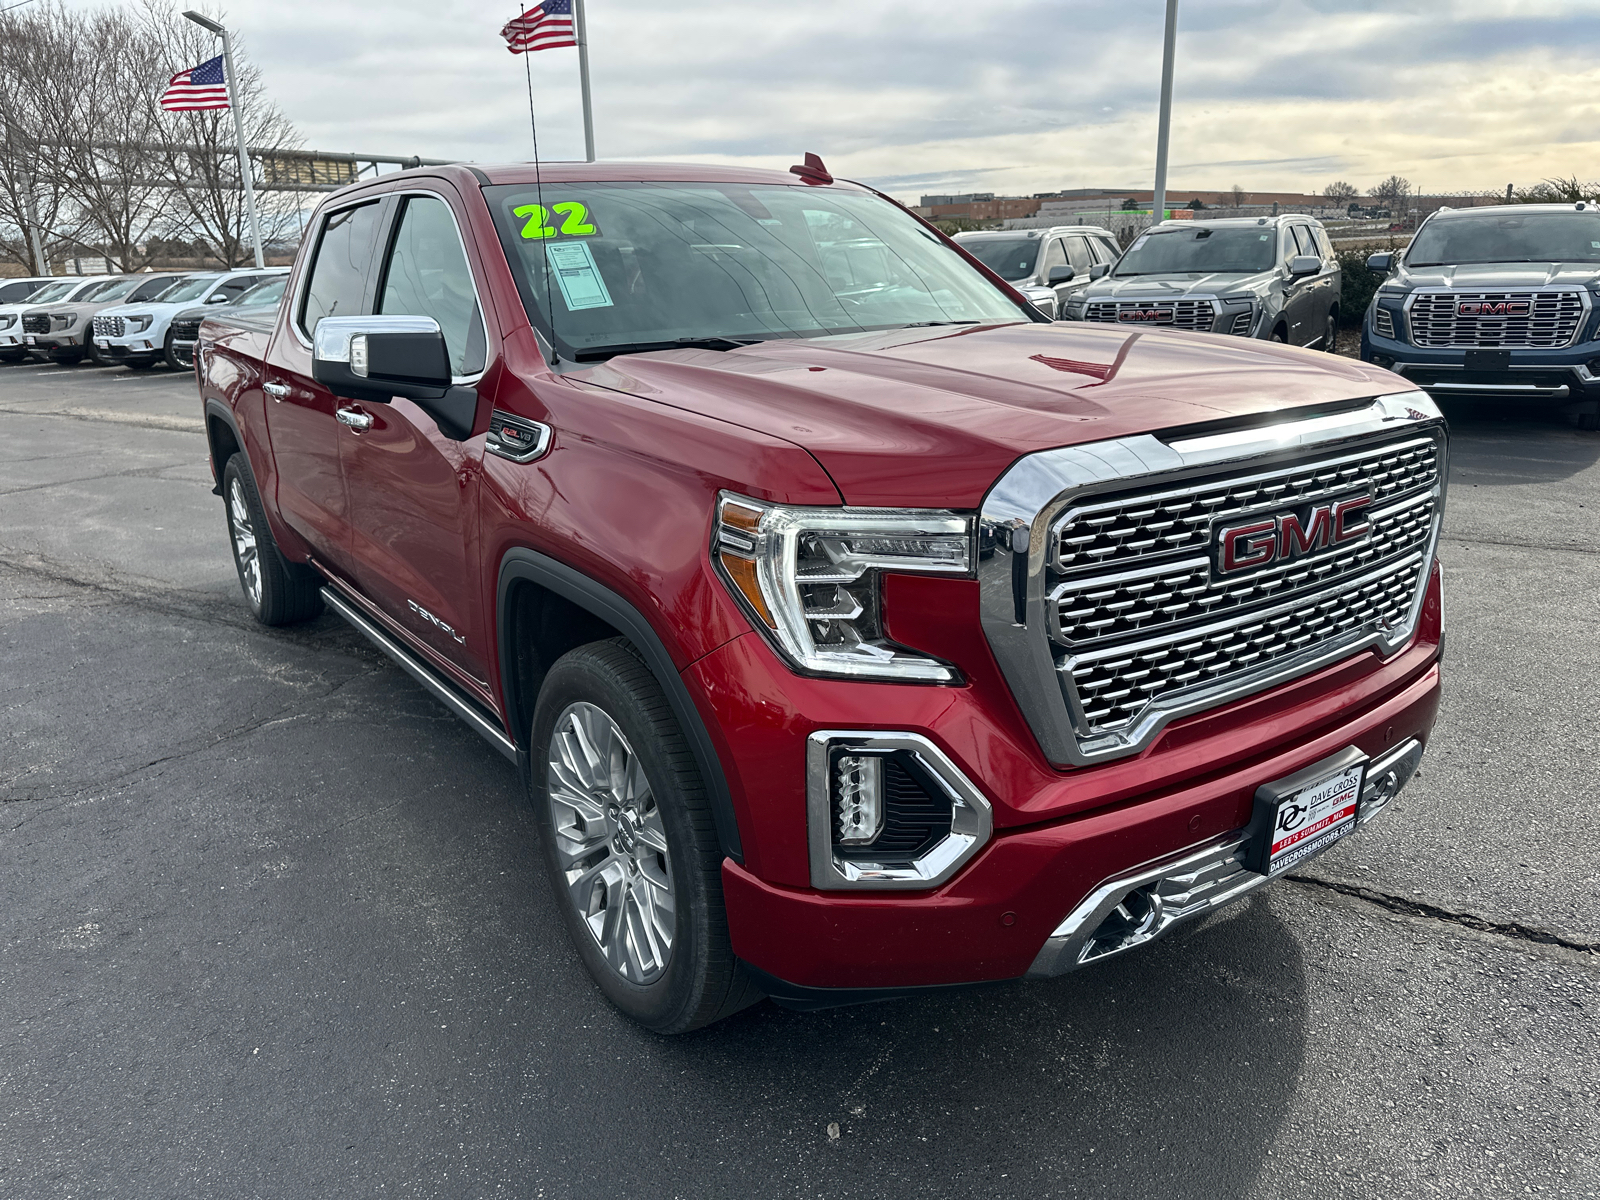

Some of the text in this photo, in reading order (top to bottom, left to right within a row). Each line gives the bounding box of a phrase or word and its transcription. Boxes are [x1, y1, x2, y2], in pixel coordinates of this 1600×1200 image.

[513, 201, 597, 239] 22
[1120, 310, 1172, 321] GMC
[1460, 302, 1529, 315] GMC
[520, 432, 532, 441] V8
[1218, 494, 1372, 575] GMC
[407, 599, 467, 647] DENALI
[1310, 787, 1333, 805] DAVE
[1333, 774, 1358, 793] CROSS
[1332, 789, 1356, 806] GMC
[1270, 821, 1355, 872] DAVECROSSMOTORS.COM
[1279, 833, 1299, 849] LEE'S
[1332, 810, 1345, 822] MO
